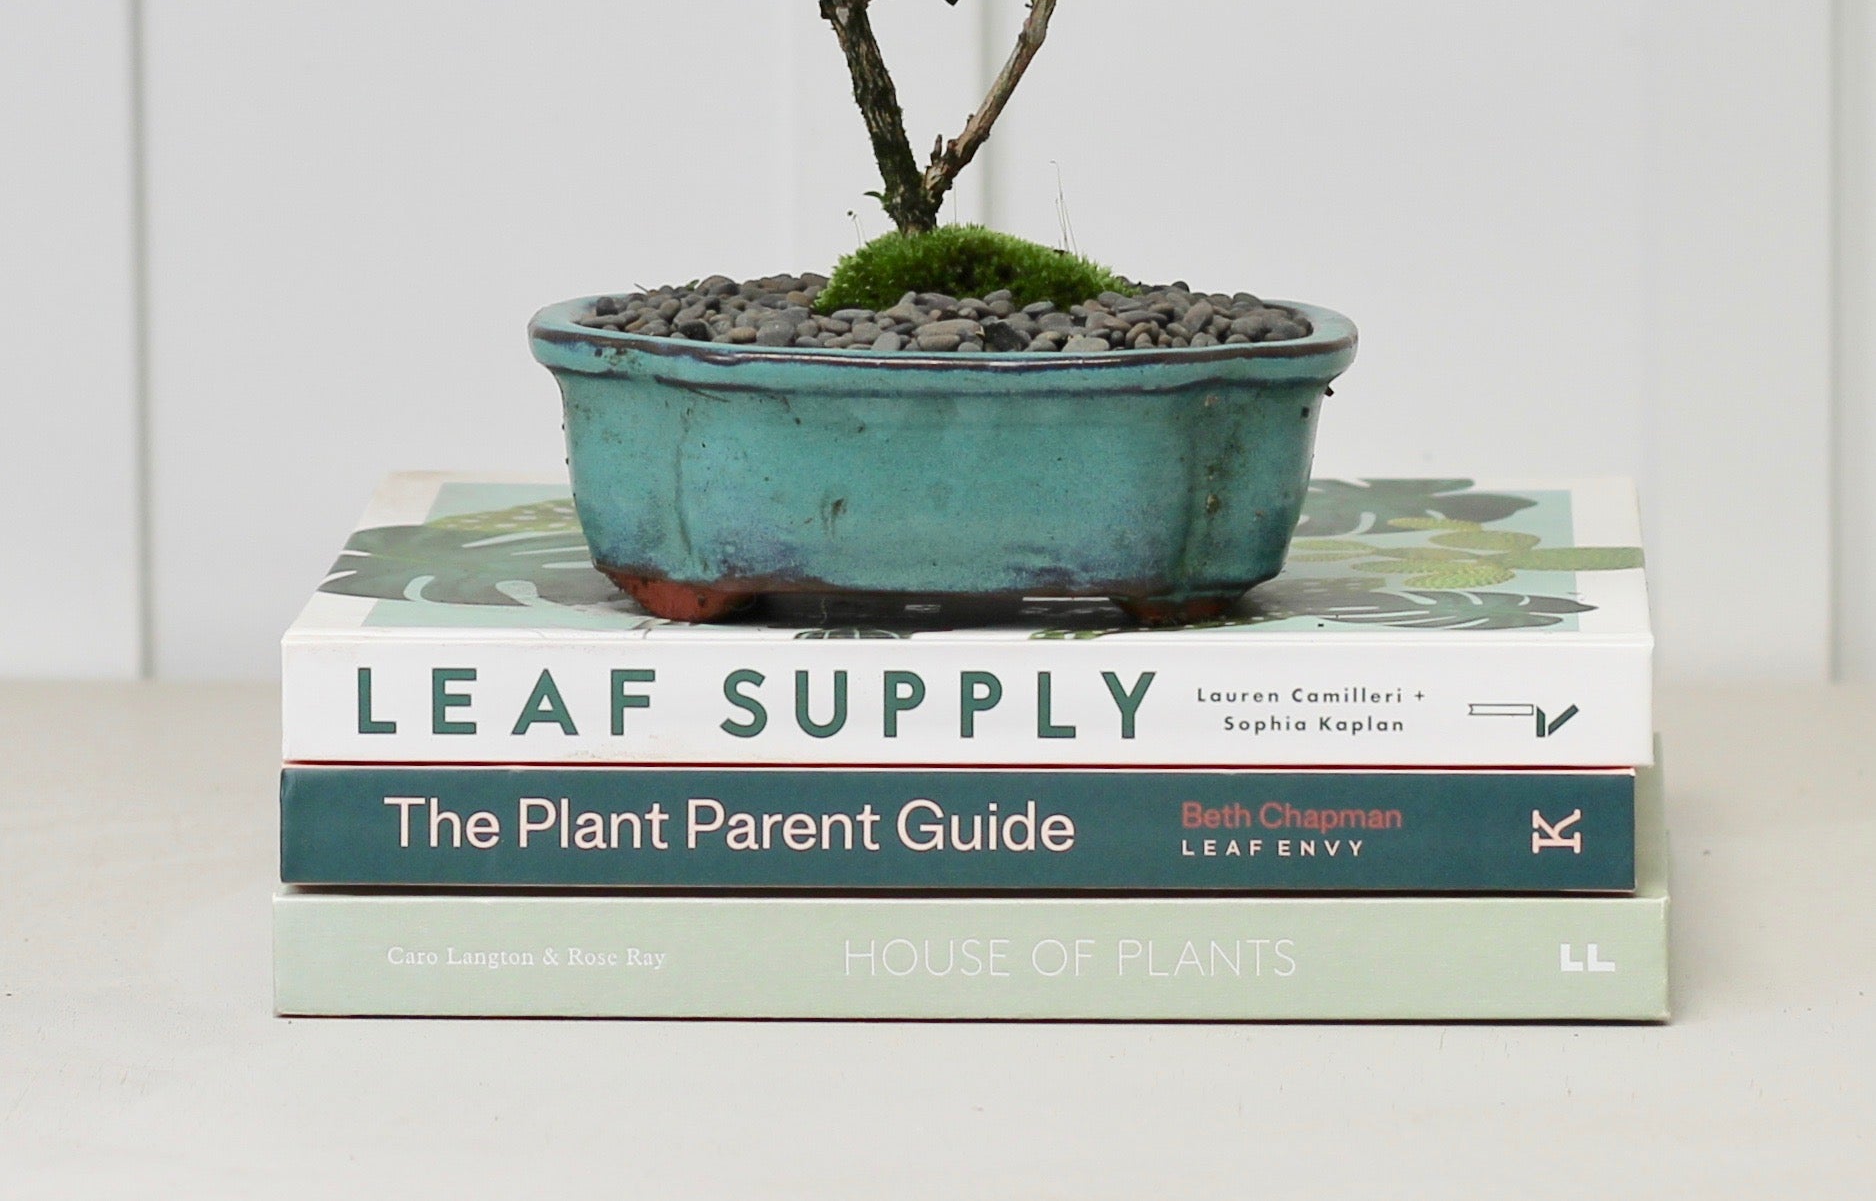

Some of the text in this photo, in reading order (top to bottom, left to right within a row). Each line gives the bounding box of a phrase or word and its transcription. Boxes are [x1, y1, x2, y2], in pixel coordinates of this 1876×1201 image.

[357, 666, 1157, 740] LEAF SUPPLY
[1197, 687, 1279, 703] Lauren
[1291, 687, 1402, 704] Camilleri
[1224, 715, 1404, 736] Sophia Kaplan
[383, 796, 1075, 852] The Plant Parent Guide
[1182, 801, 1403, 835] Beth Chapman
[1531, 808, 1582, 854] K
[1181, 839, 1363, 857] LEAF ENVY
[386, 945, 667, 971] Caro Langton & Rose Ray
[844, 938, 1297, 977] HOUSE OF PLANTS
